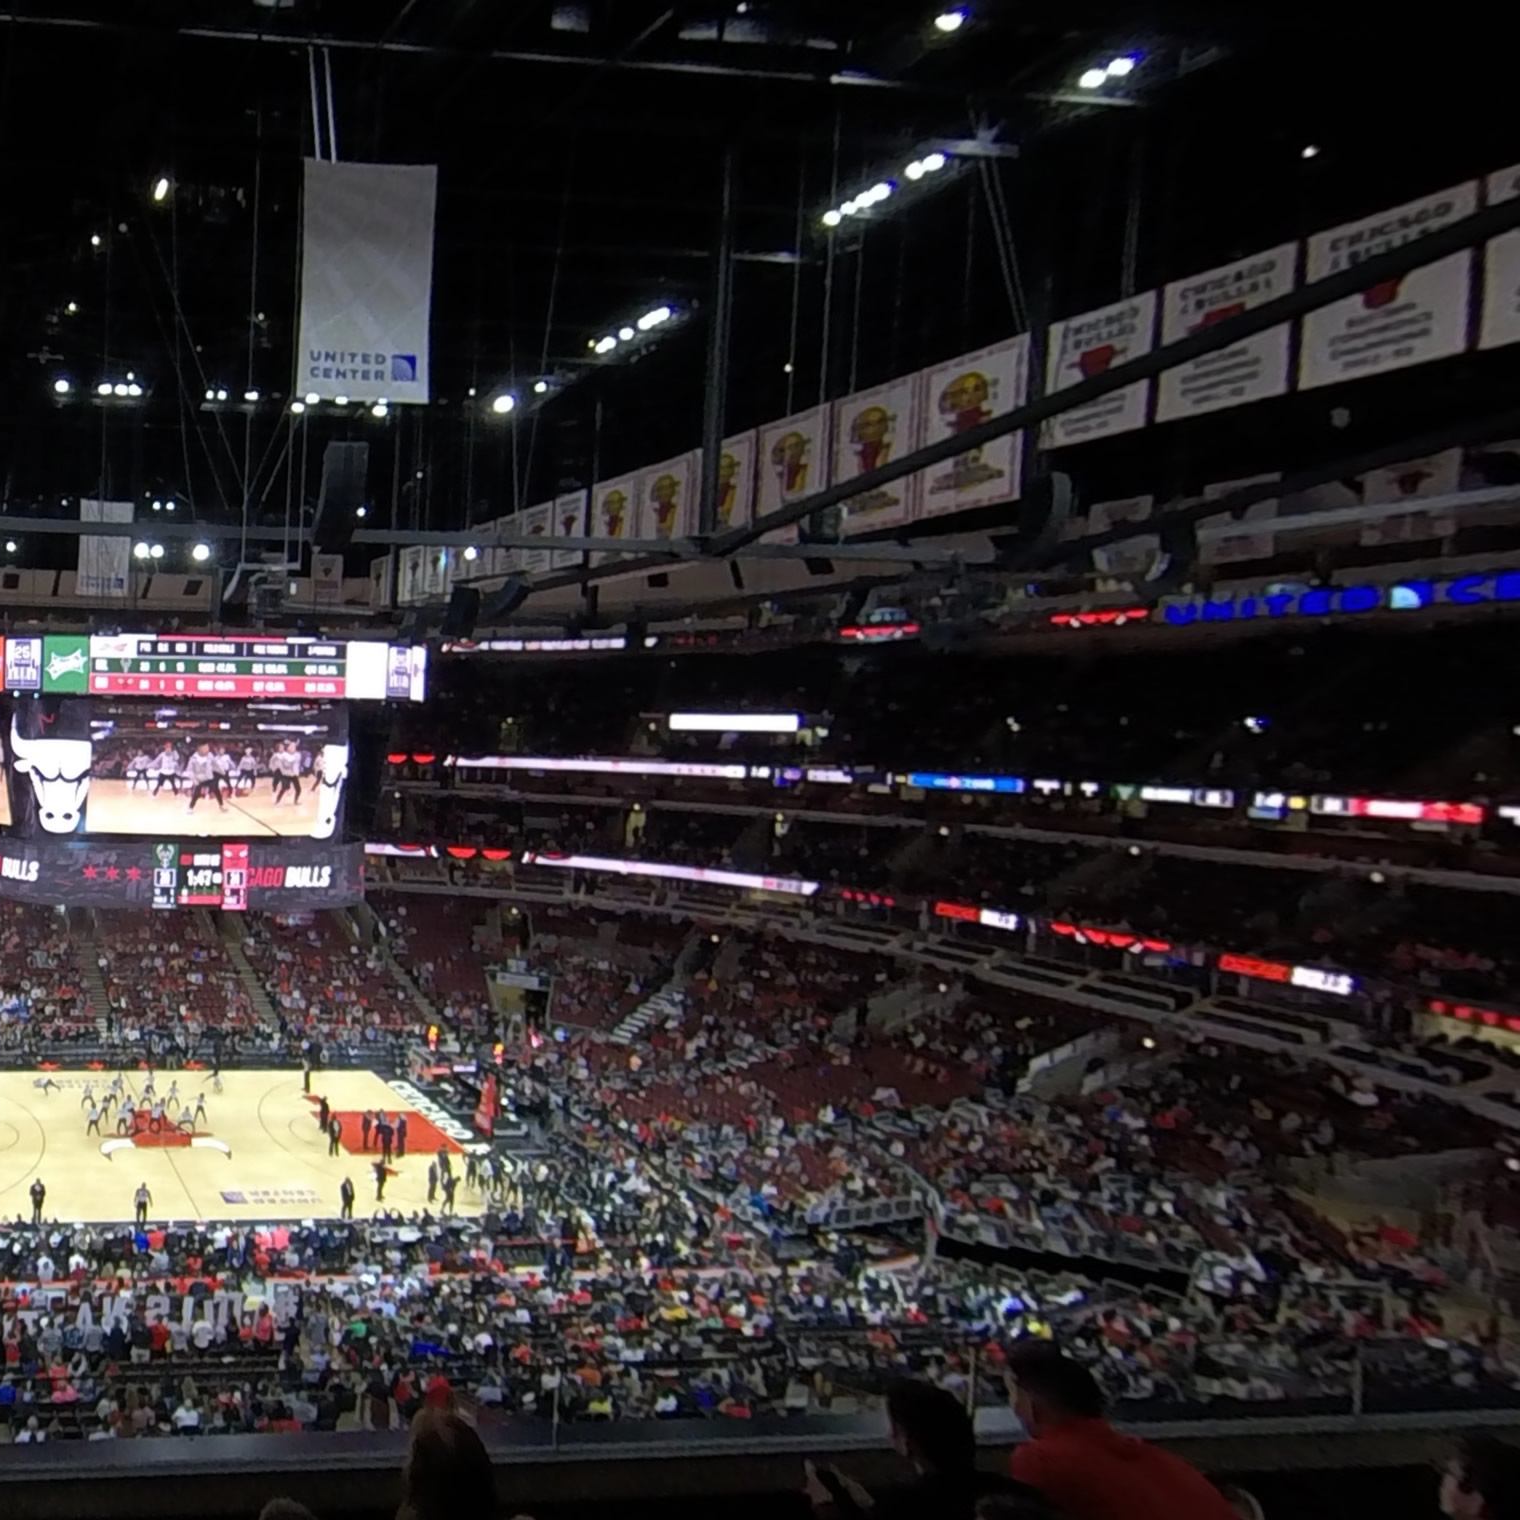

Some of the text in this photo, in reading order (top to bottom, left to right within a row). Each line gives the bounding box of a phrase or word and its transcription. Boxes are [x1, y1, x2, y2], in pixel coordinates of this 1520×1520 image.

[1328, 200, 1455, 252] CHICAGO
[1179, 259, 1277, 301] CHICAGO
[309, 349, 387, 365] UNITED
[309, 365, 386, 381] CENTER
[1164, 585, 1380, 626] UNITED
[1, 856, 40, 882] BULLS
[285, 865, 332, 887] BULLS
[386, 1080, 474, 1140] CHICAGO
